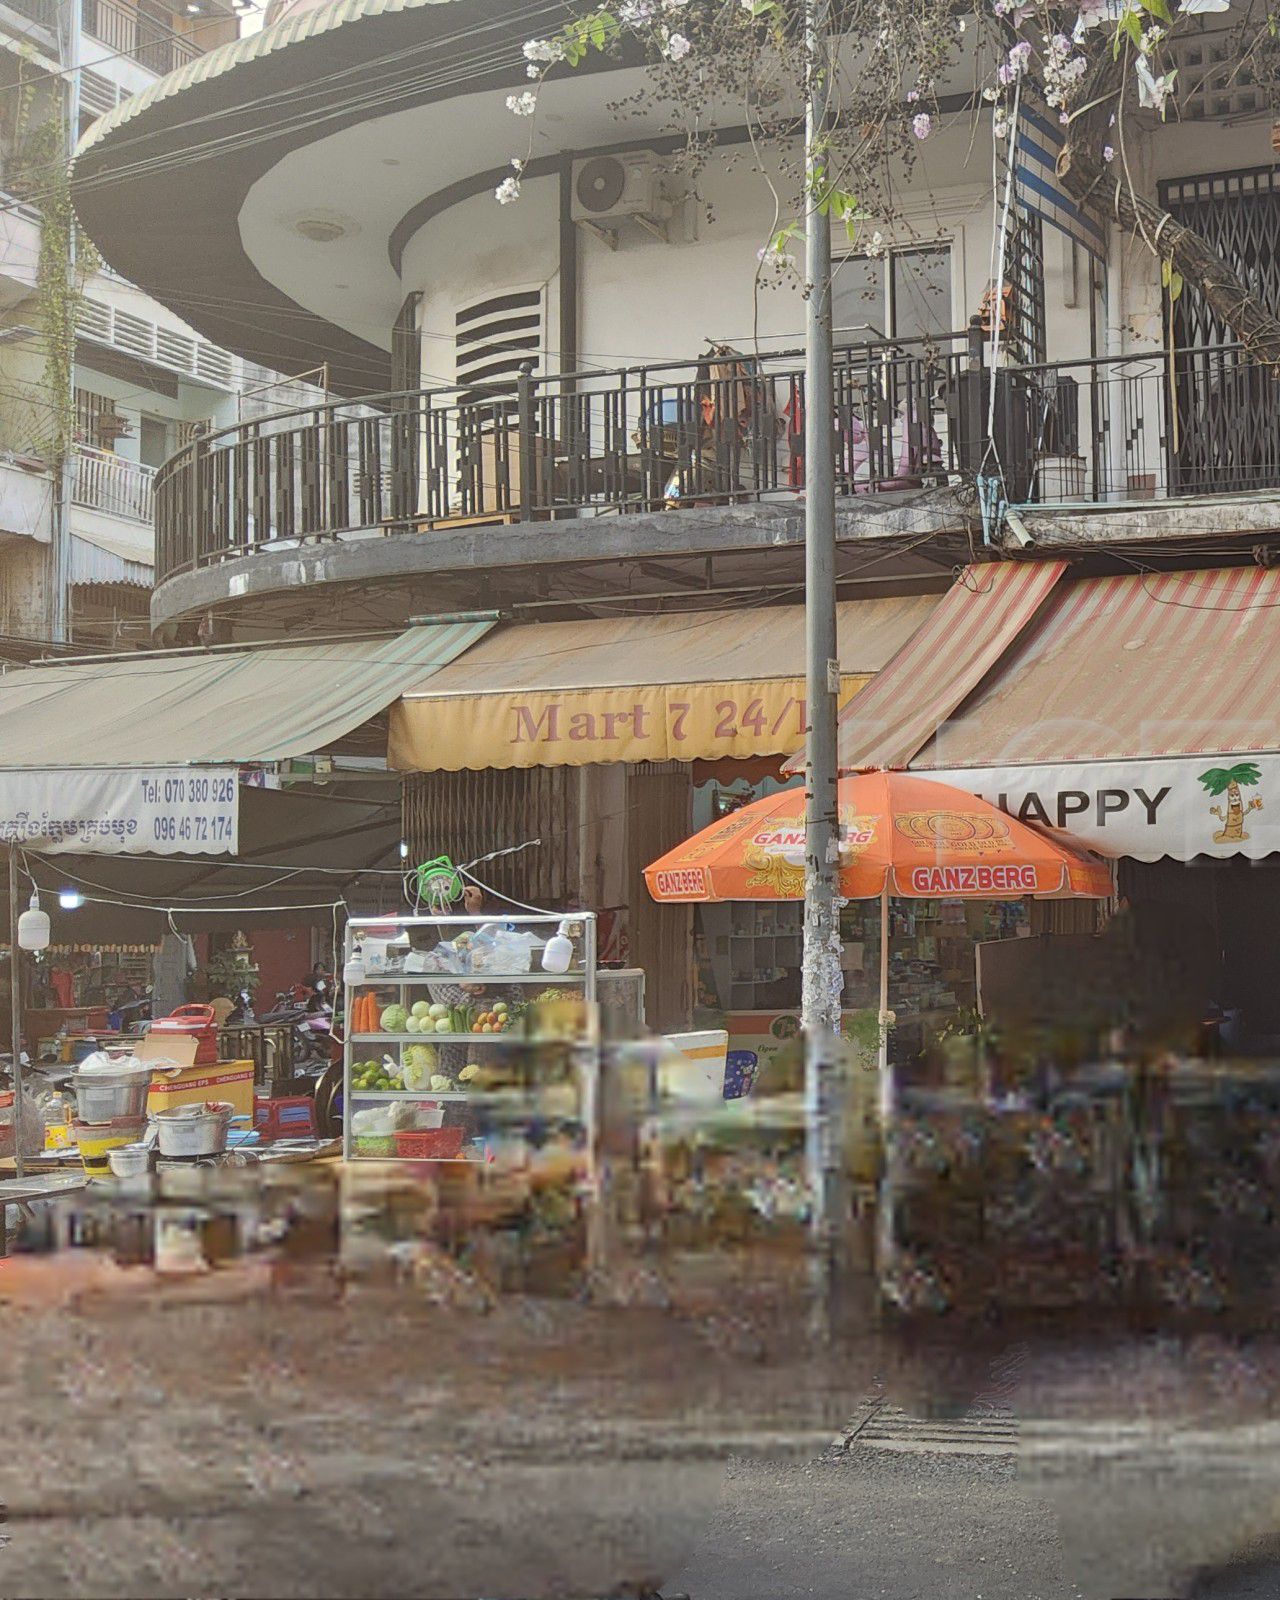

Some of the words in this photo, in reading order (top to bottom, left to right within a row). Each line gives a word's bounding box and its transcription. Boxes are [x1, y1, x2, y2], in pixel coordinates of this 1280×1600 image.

[509, 703, 651, 744] Mart
[668, 702, 691, 742] 7
[141, 779, 161, 803] Tel:
[164, 779, 185, 802] 070
[188, 779, 209, 802] 380
[211, 778, 234, 802] 926
[154, 816, 176, 841] 096
[179, 817, 191, 841] 46
[194, 816, 208, 841] 72
[210, 816, 232, 841] 174
[753, 830, 874, 846] GANZRG
[656, 867, 705, 894] GANZBERG
[912, 865, 1037, 892] GANZBERG
